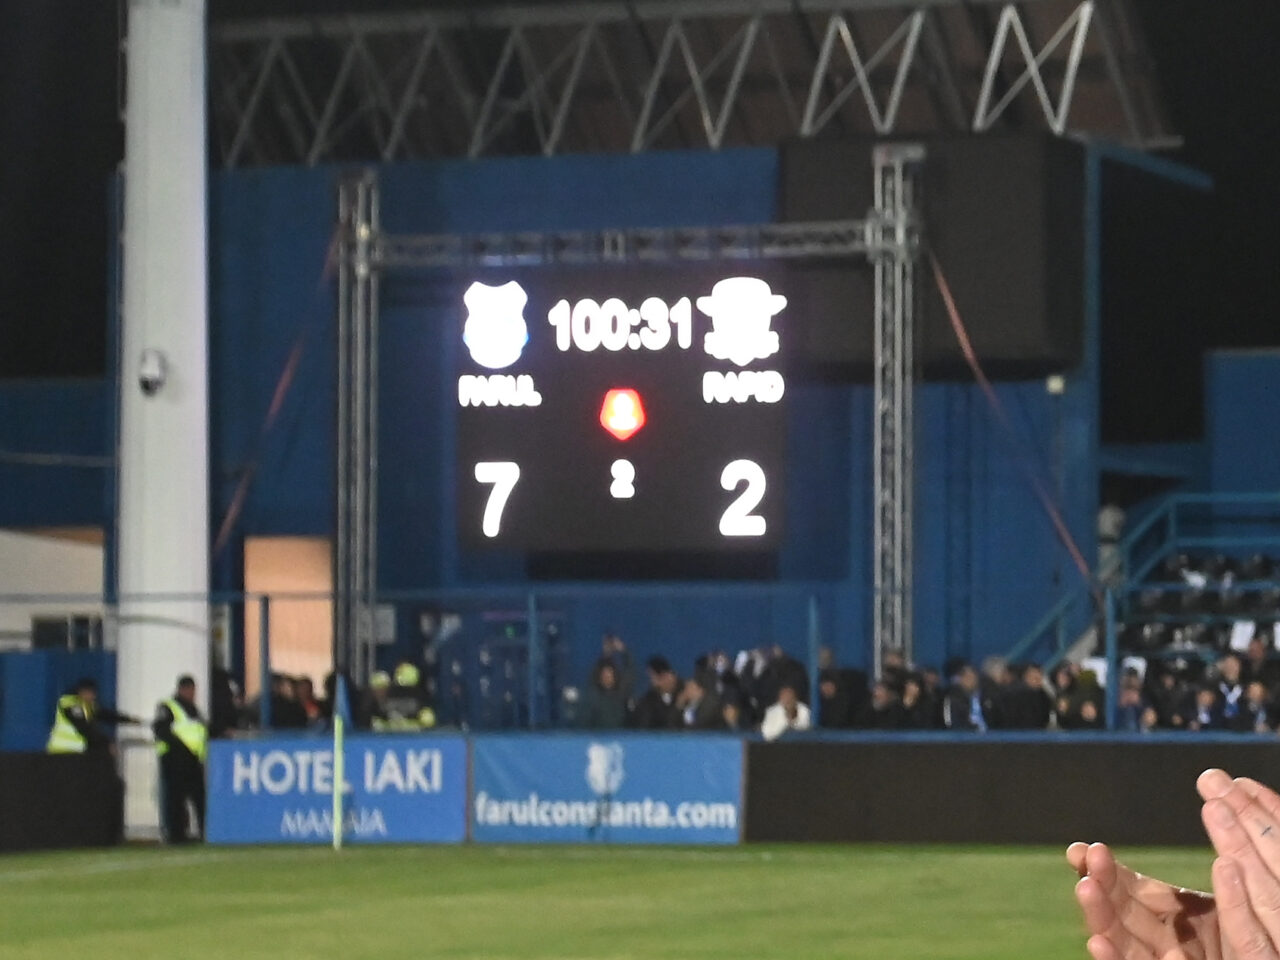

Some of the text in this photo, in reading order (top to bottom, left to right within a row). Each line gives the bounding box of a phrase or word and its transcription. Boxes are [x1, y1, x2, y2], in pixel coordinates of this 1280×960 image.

[548, 297, 692, 351] 100:31
[474, 461, 520, 537] 7
[719, 459, 767, 536] 2
[364, 748, 443, 794] IAKI
